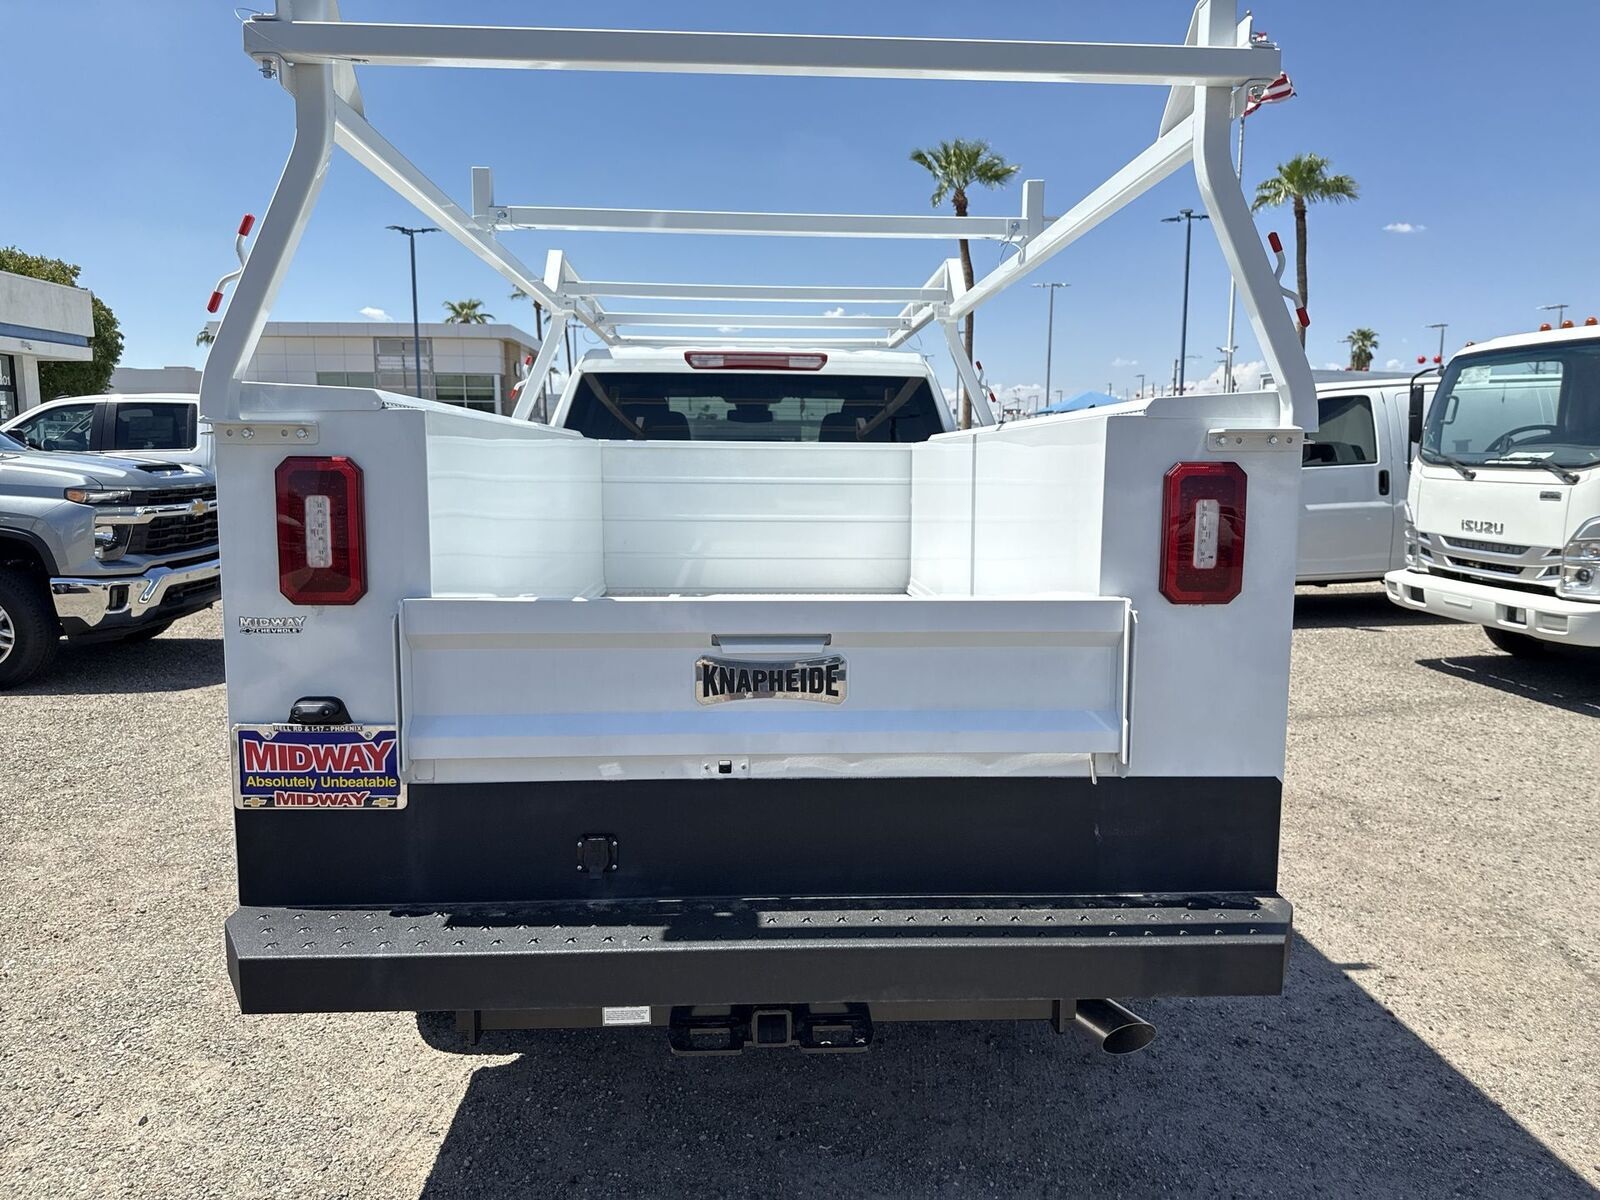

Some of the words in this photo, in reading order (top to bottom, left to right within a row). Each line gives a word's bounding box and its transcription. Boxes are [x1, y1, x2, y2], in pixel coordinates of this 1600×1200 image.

[1461, 519, 1504, 535] ISUZU
[239, 616, 306, 627] MIDWAY
[702, 664, 839, 697] KNAPHEIDE
[243, 739, 397, 773] MIDWAY
[246, 776, 317, 790] Absolutely
[321, 776, 397, 788] Unbeatable
[274, 791, 370, 807] MIDWAY
